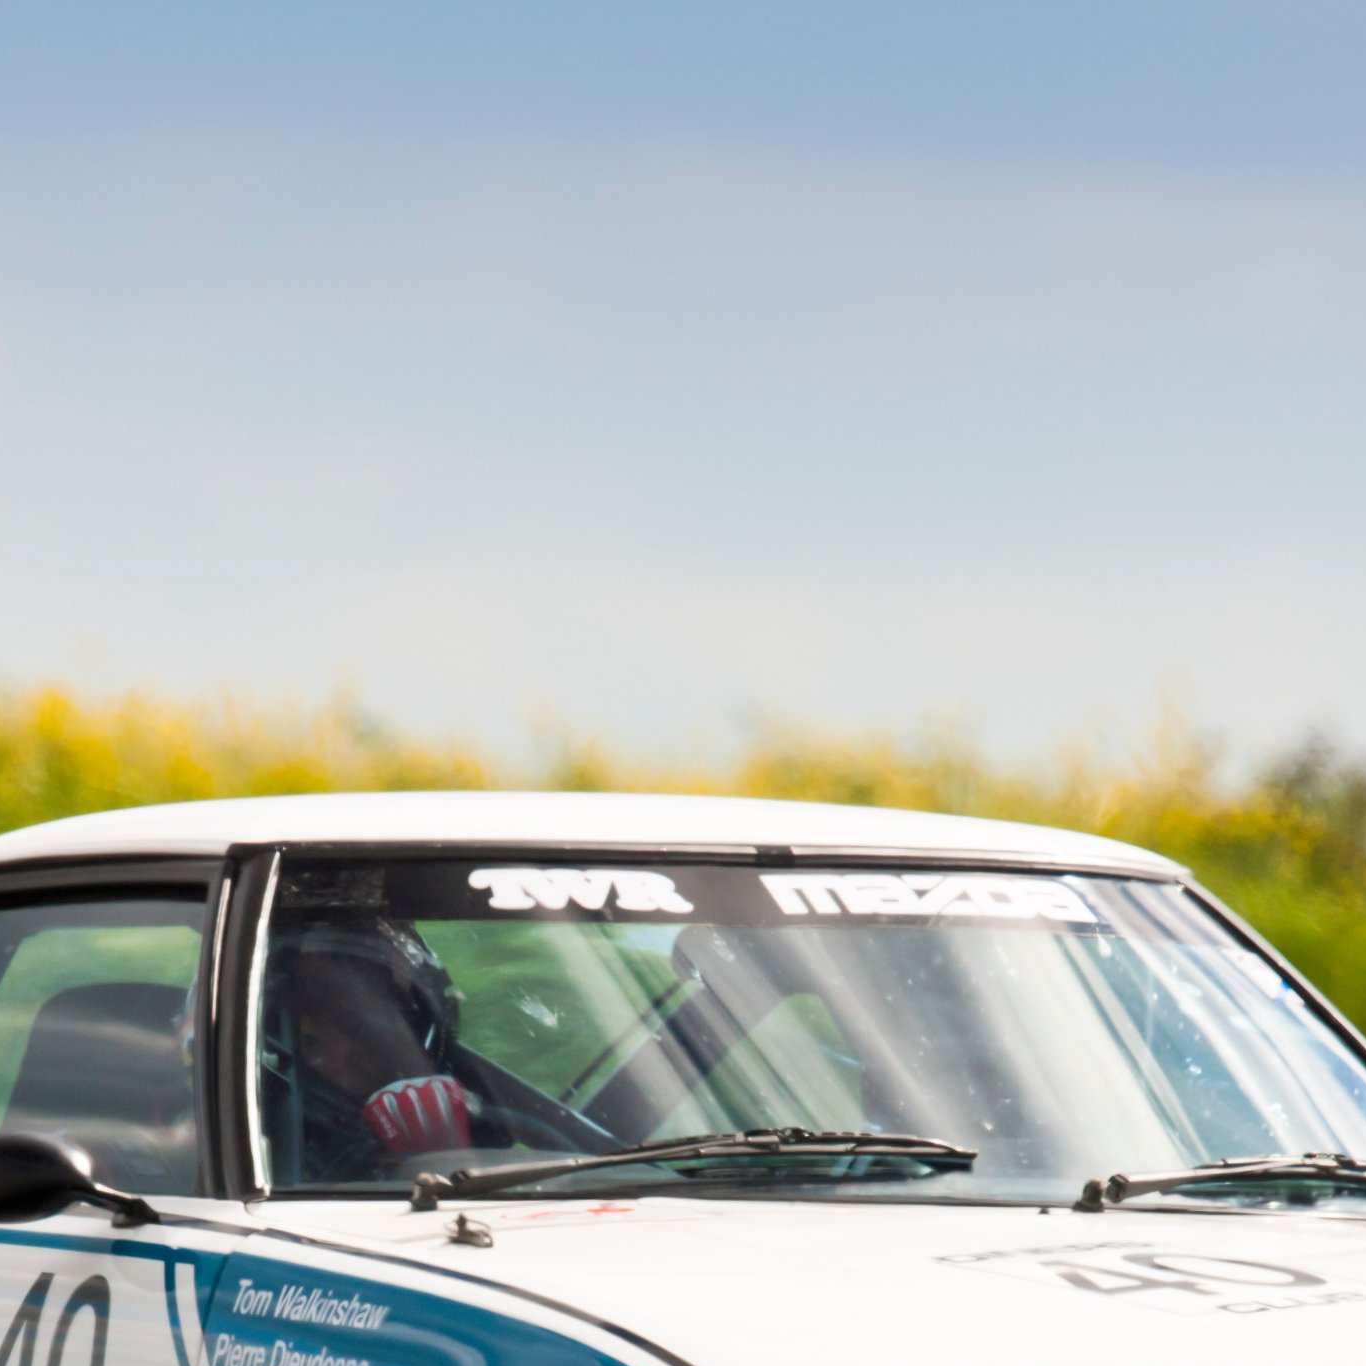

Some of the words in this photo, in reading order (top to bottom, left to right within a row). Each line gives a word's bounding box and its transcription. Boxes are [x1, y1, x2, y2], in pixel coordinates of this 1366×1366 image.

[468, 867, 695, 914] TWR
[1039, 1253, 1328, 1295] 40
[232, 1278, 274, 1317] Tom
[273, 1284, 390, 1330] Walkinshaw
